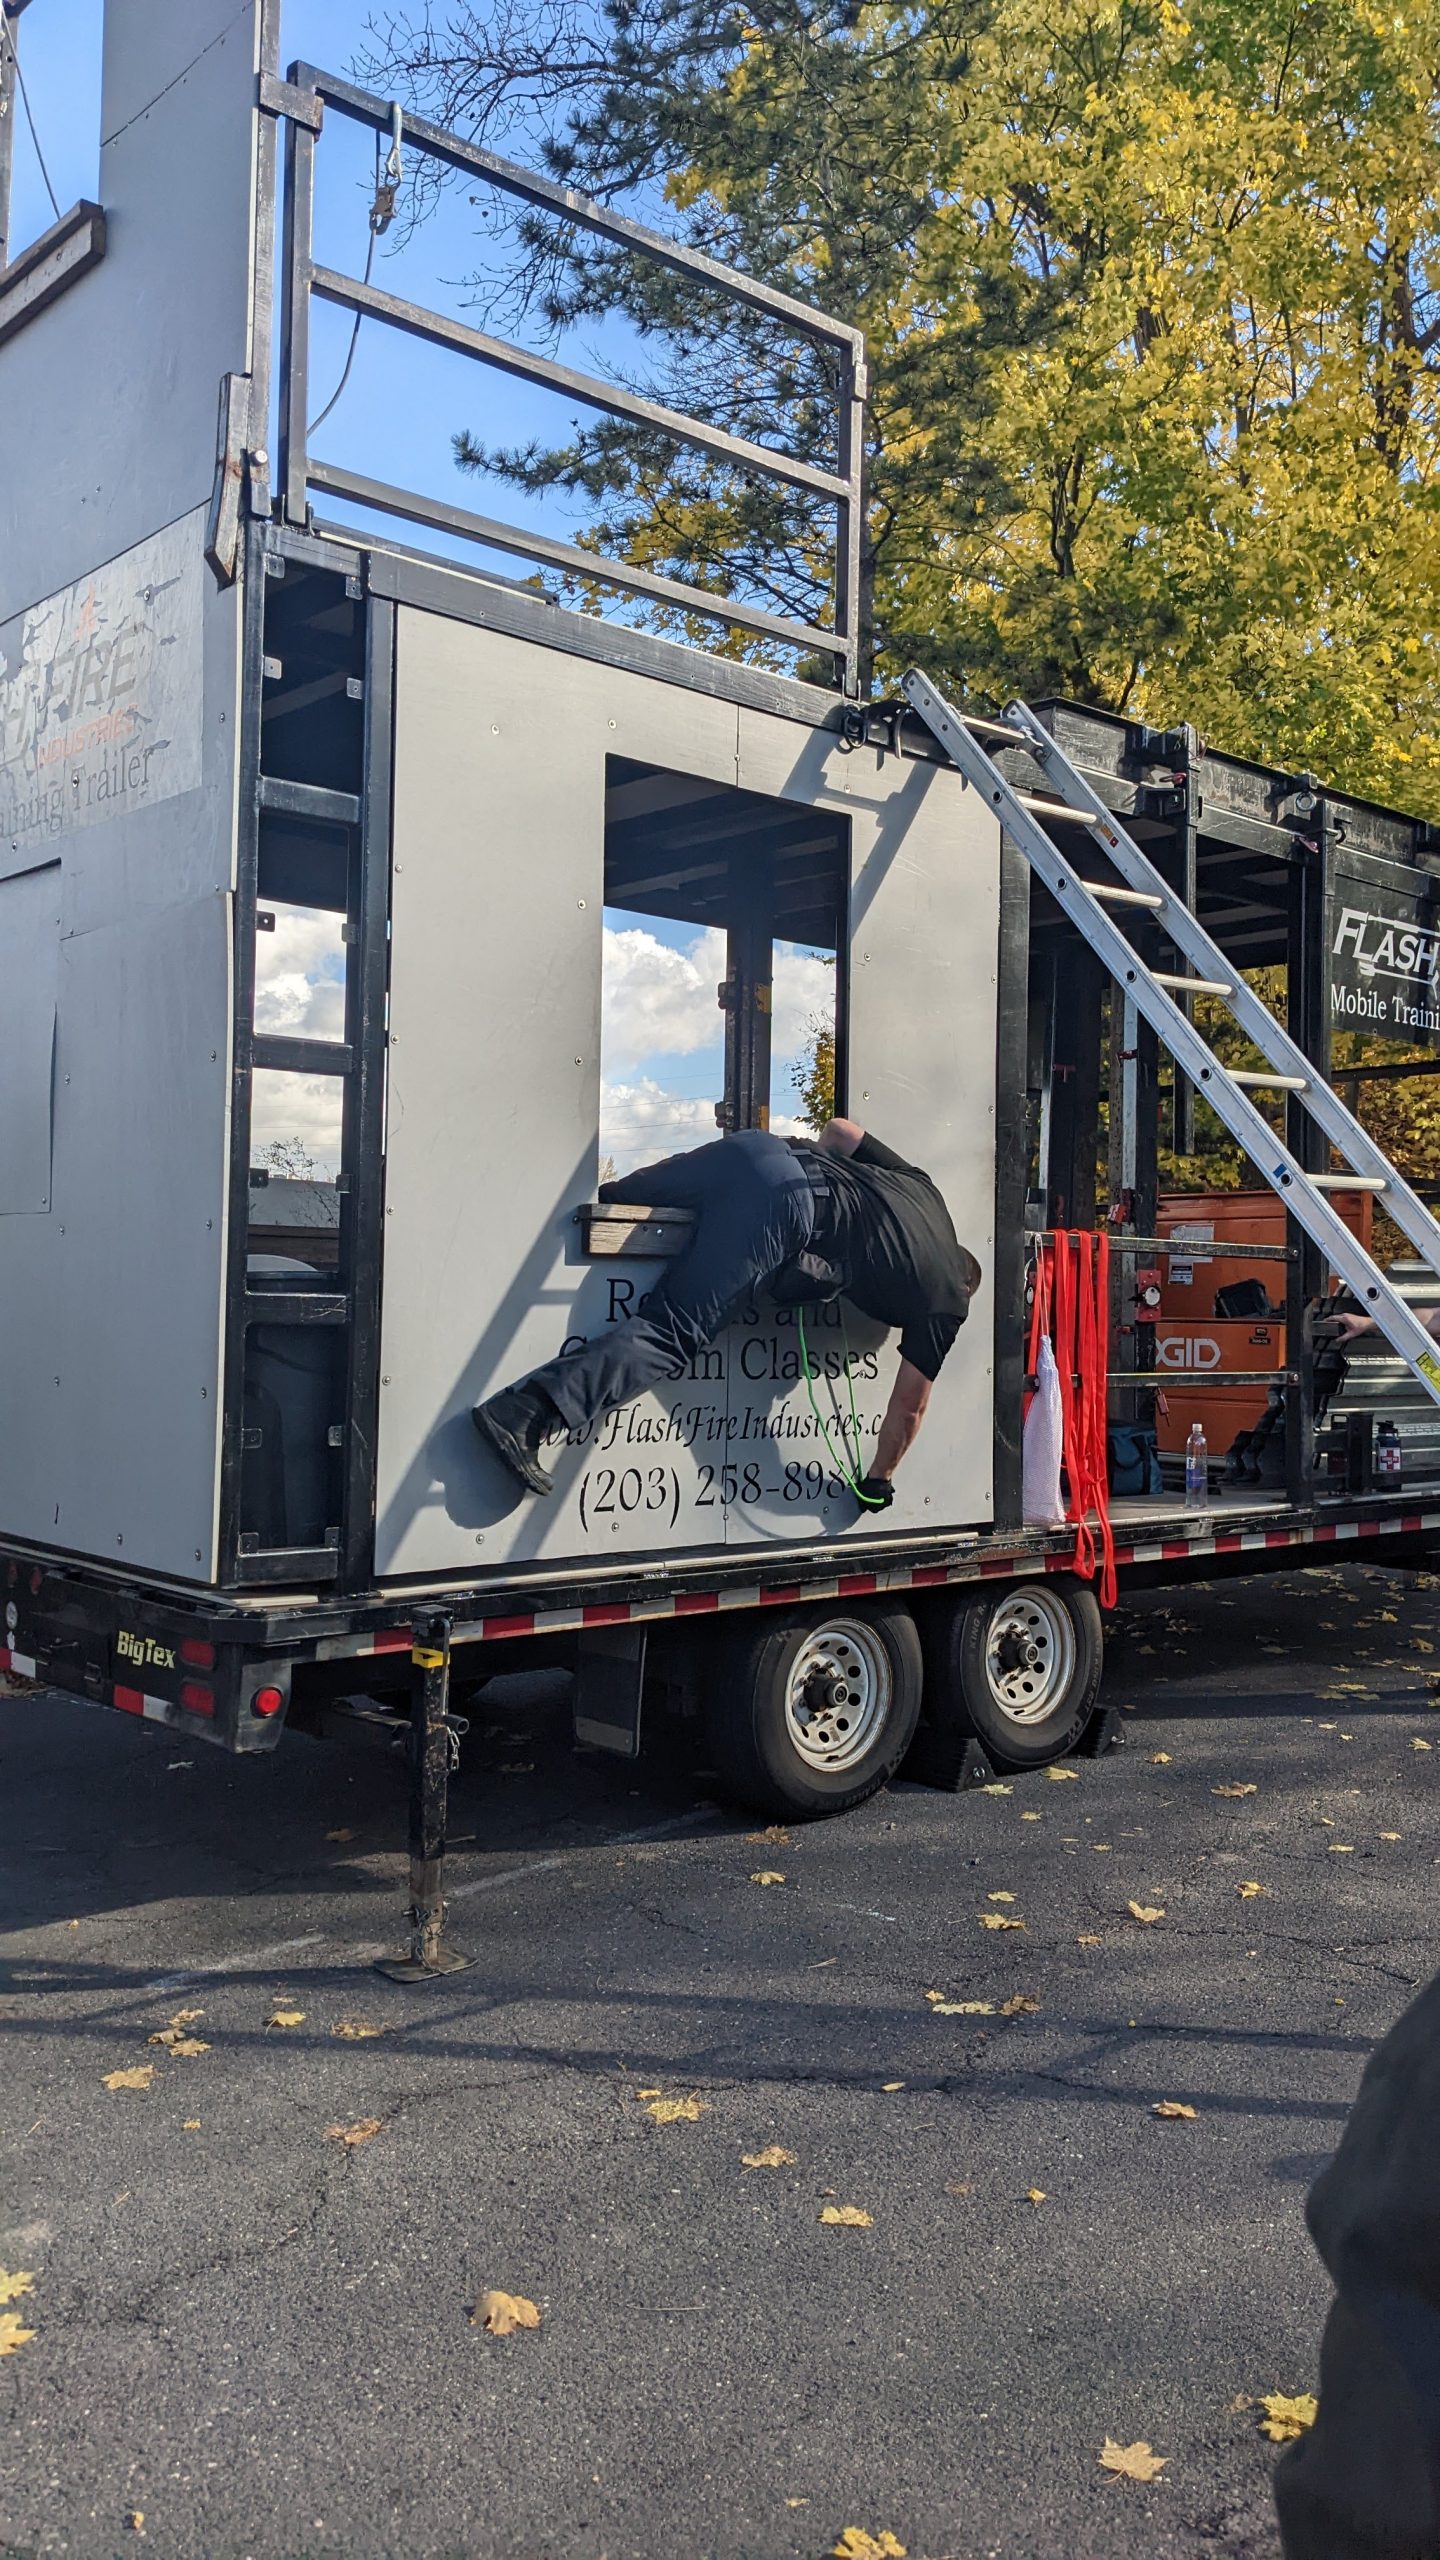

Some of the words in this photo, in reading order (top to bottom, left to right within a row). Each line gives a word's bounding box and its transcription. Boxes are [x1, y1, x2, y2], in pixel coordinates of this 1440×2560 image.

[72, 745, 152, 812] Trailer
[1332, 907, 1440, 976] FLASH
[1331, 984, 1387, 1020] Mobile
[741, 1337, 879, 1382] Classes
[1155, 1337, 1221, 1369] GID
[579, 1466, 681, 1533] (203)
[117, 1630, 176, 1669] BigTex
